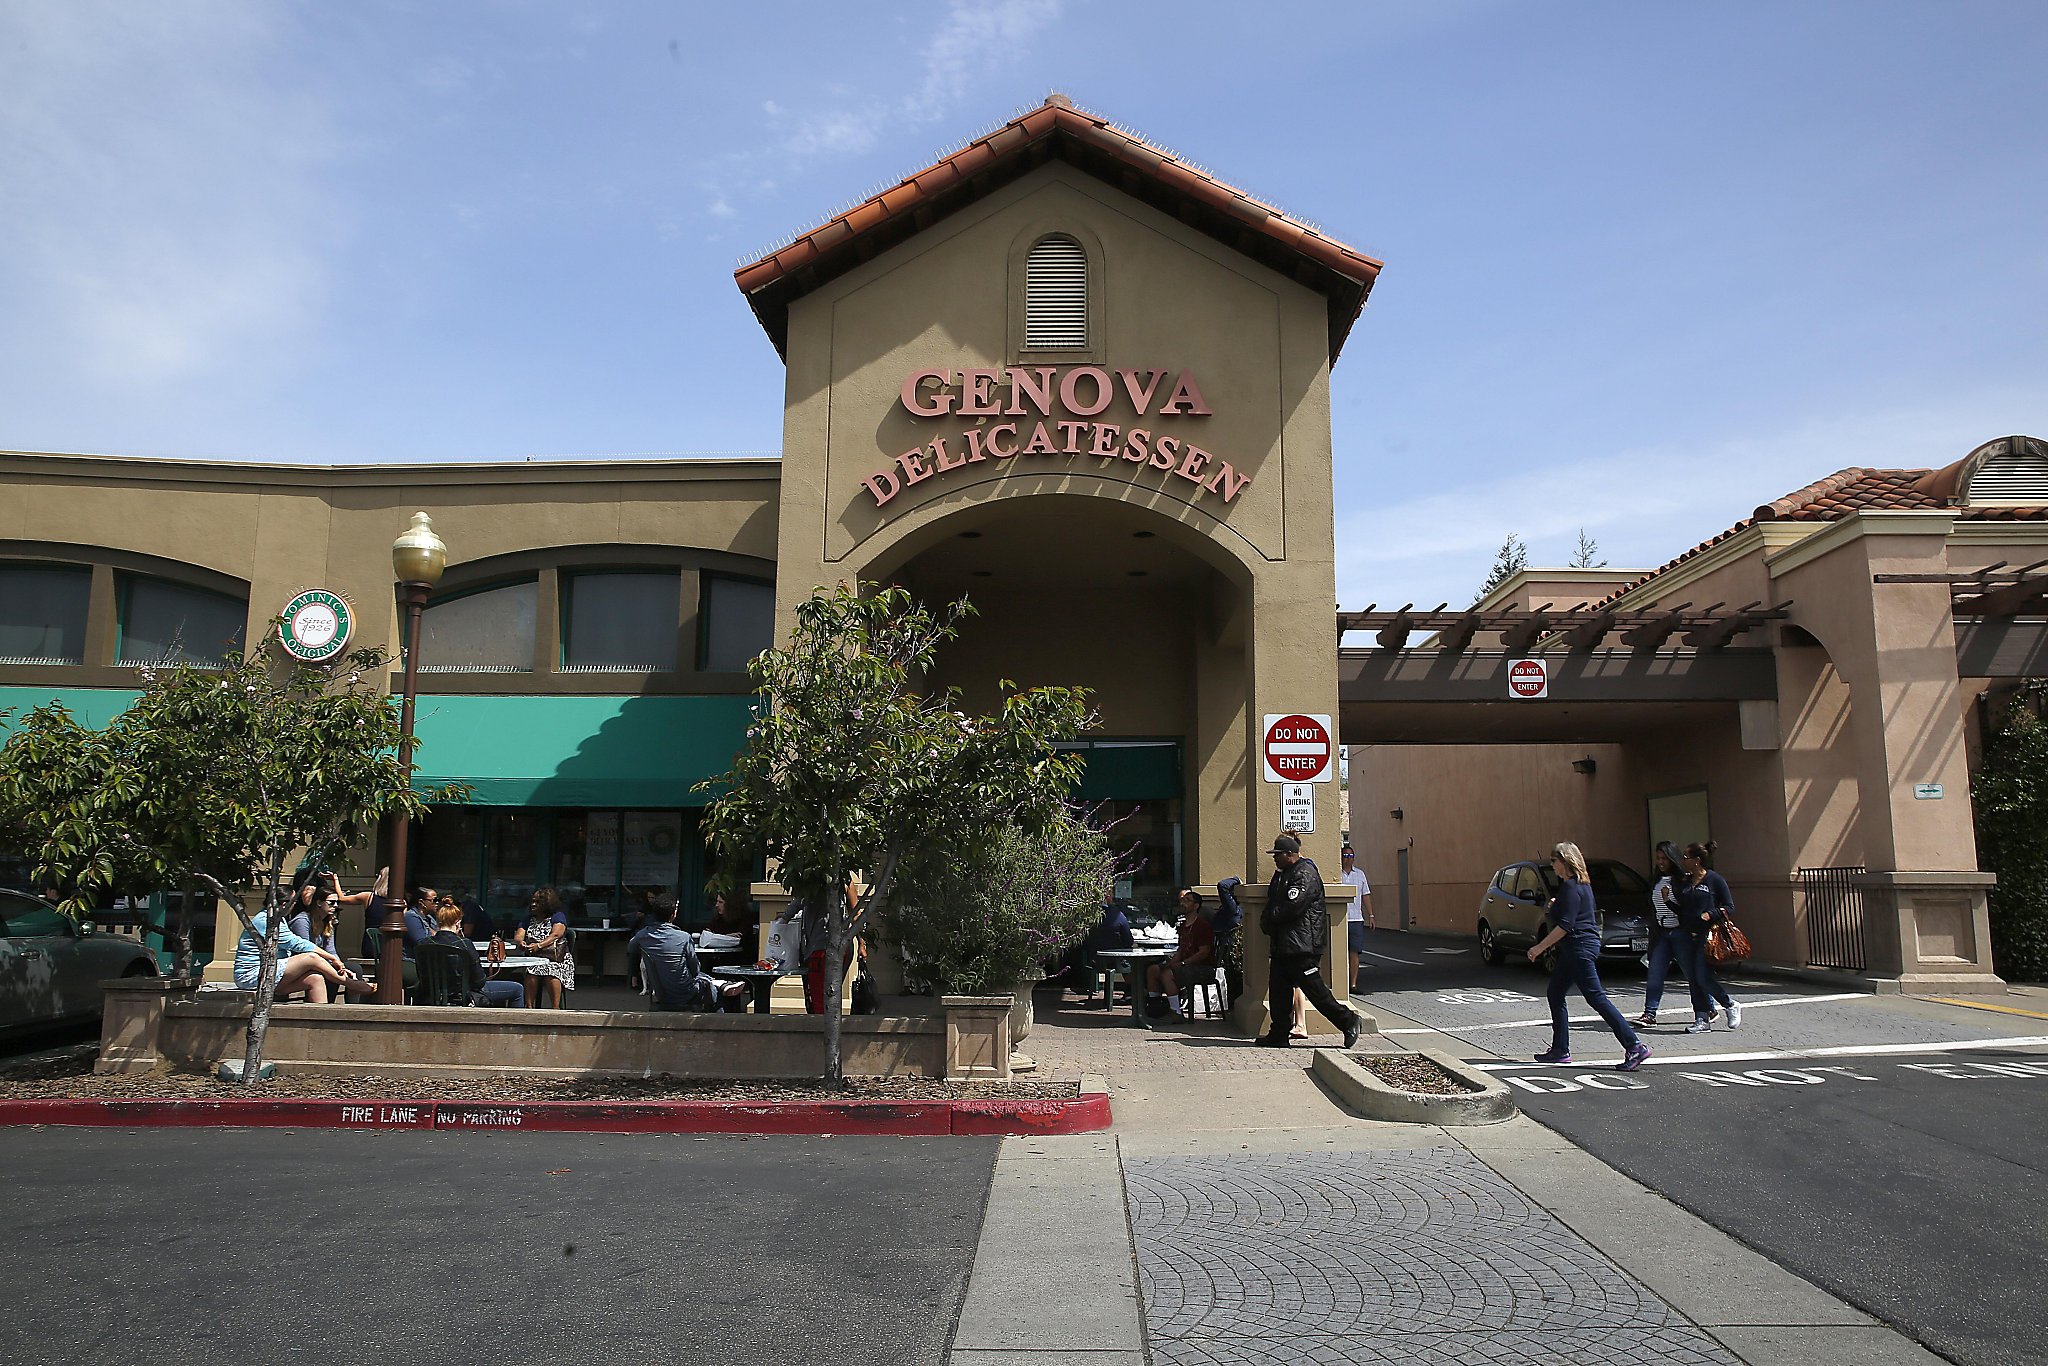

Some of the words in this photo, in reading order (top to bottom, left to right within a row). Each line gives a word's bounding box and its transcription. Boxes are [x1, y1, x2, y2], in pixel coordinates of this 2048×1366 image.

[900, 366, 1213, 417] GENOVA
[861, 420, 1251, 508] DELICATESSEN
[283, 593, 348, 624] DOMINIC'S
[287, 636, 344, 658] ORIGINAL
[1275, 728, 1291, 739] DO
[1296, 728, 1319, 739] NOT
[1279, 758, 1316, 769] ENTER
[1285, 798, 1311, 806] LOITERING
[1293, 788, 1301, 796] NO
[1502, 1073, 1651, 1094] DO
[1676, 1065, 1879, 1087] NOT
[341, 1106, 374, 1123] FIRE
[380, 1107, 418, 1124] LANE
